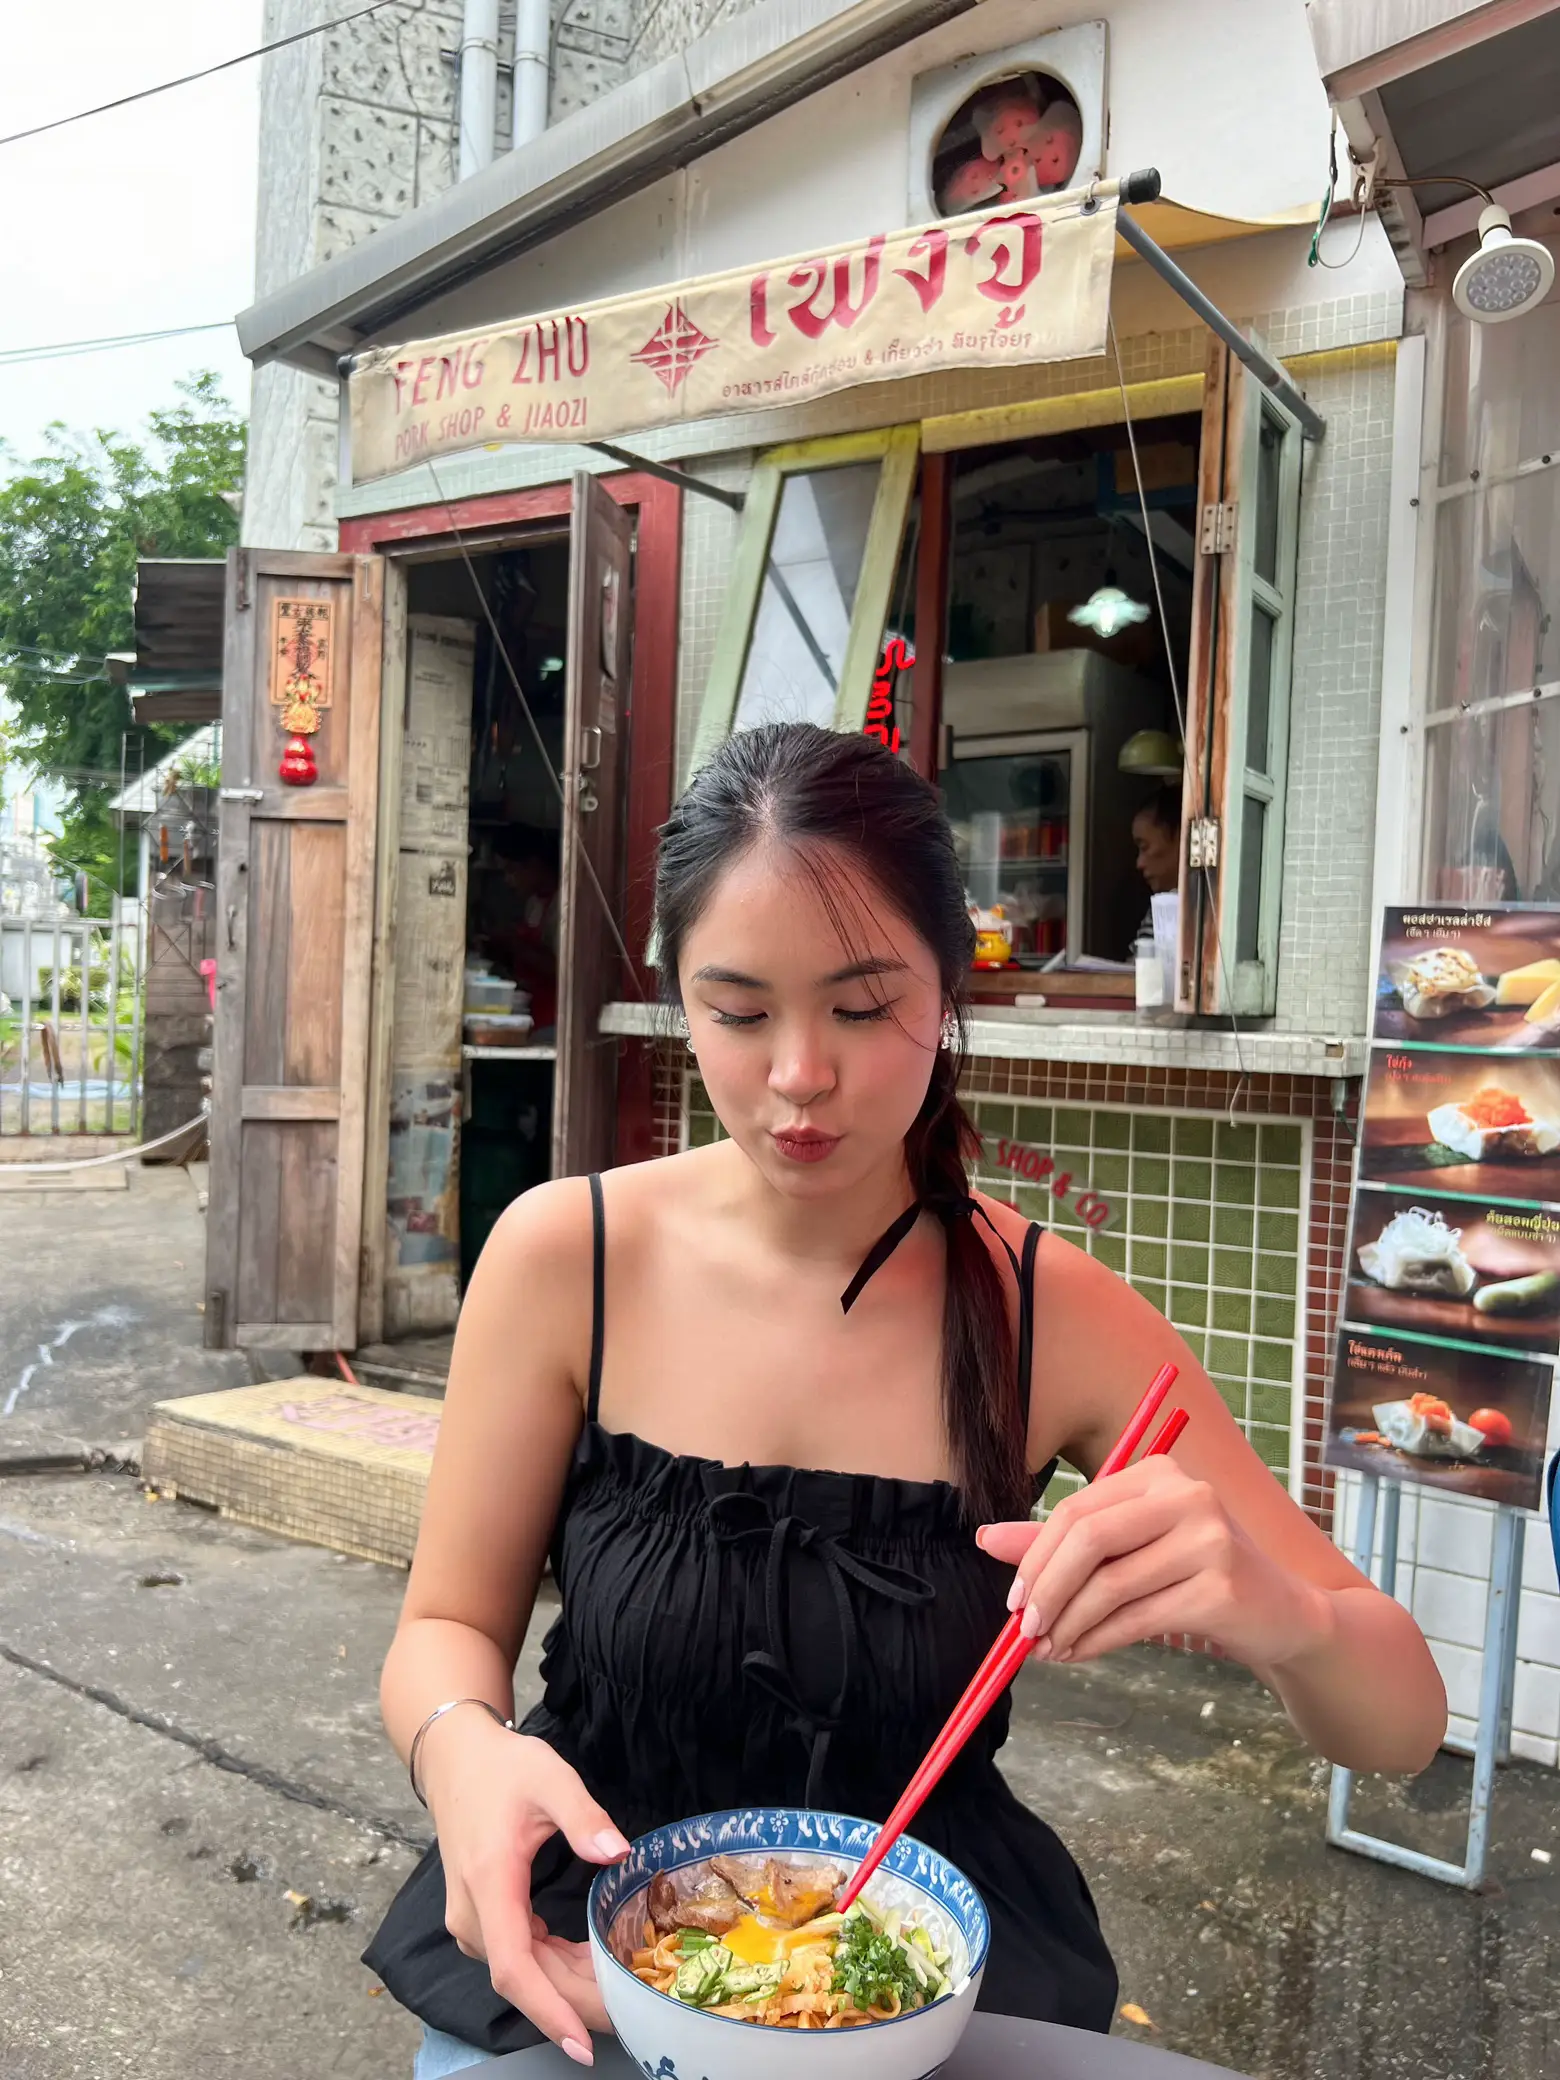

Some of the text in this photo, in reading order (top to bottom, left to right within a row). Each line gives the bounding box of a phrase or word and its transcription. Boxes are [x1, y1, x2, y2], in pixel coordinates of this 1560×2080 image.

[393, 315, 590, 415] FENG ZHU
[863, 349, 874, 367] &
[395, 397, 588, 461] PORK SHOP & JIAOZI
[994, 1137, 1056, 1183] SHOP
[1052, 1171, 1073, 1200] &
